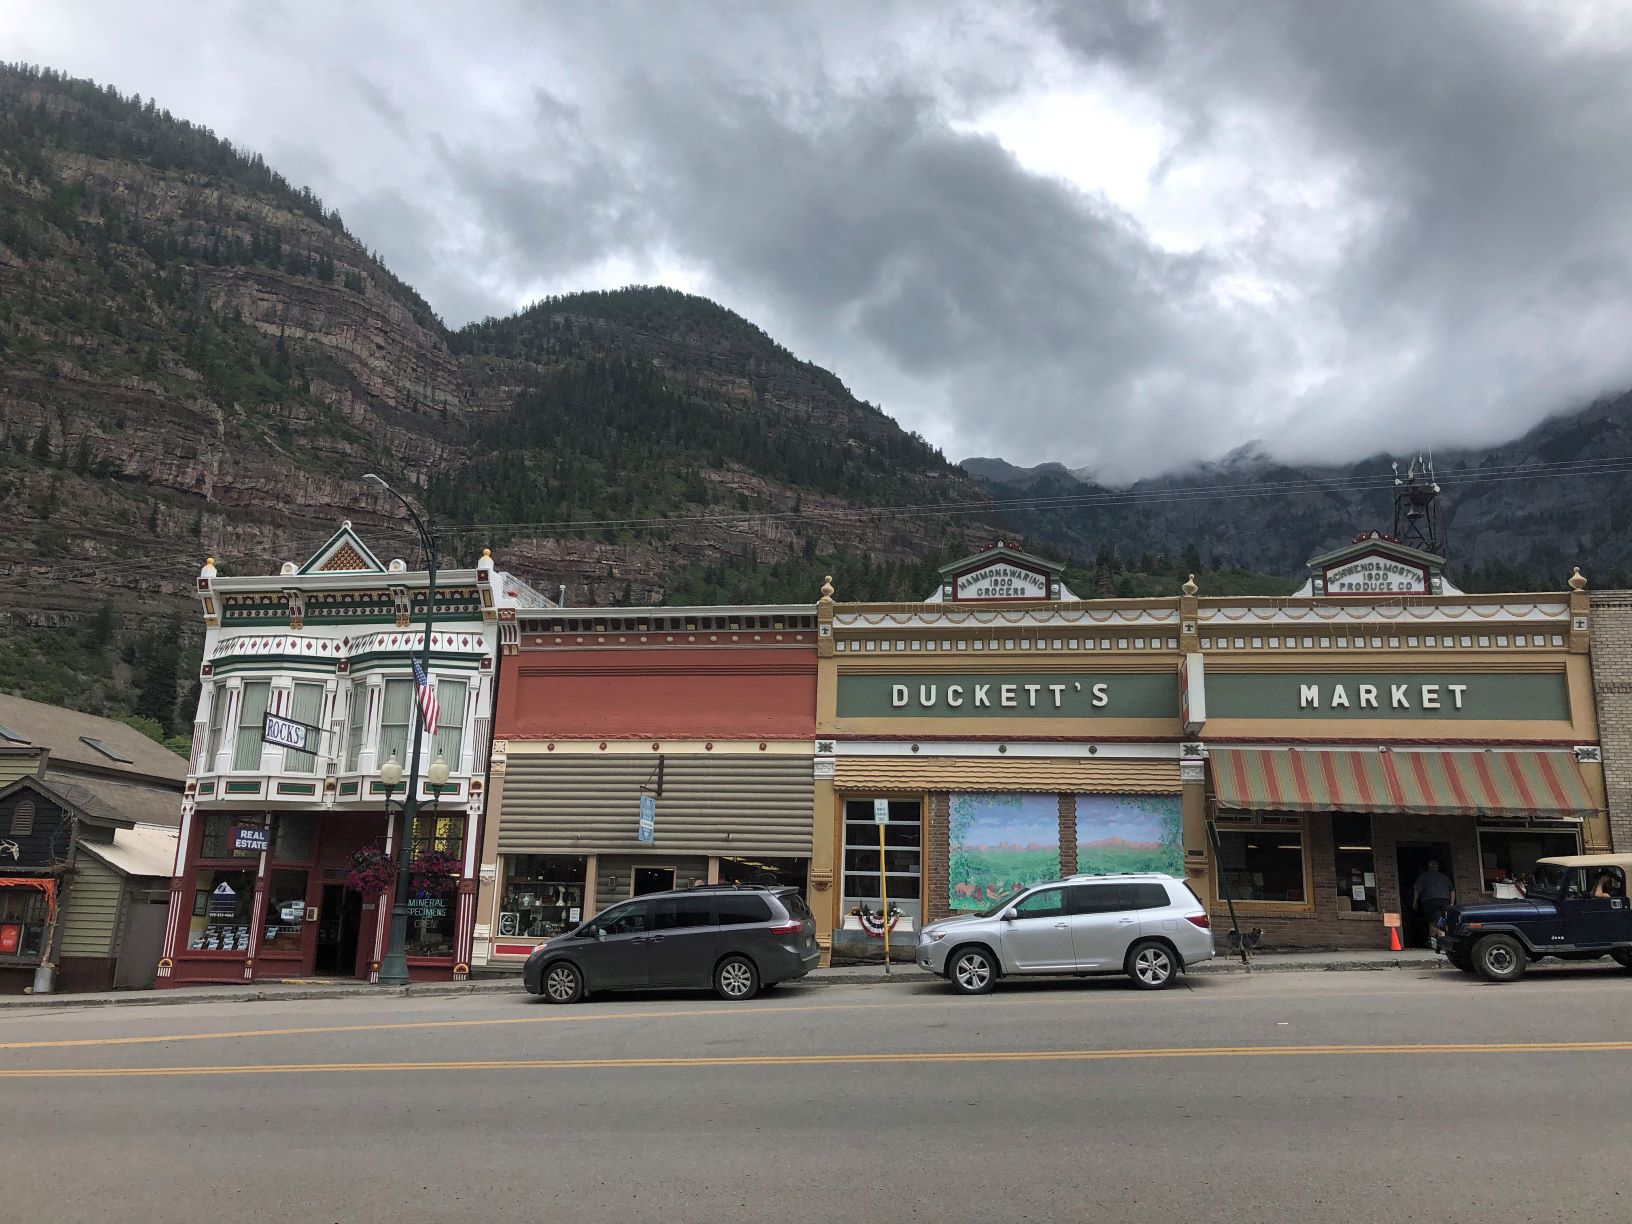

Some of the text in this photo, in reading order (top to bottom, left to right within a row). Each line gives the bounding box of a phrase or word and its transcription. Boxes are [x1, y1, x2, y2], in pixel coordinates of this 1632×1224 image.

[1363, 572, 1389, 582] 1900
[989, 578, 1013, 588] 1900
[1340, 581, 1413, 592] PRODUCE CO
[976, 587, 1026, 597] GROCERS
[892, 681, 1108, 708] DUCKETT'S
[1300, 684, 1467, 709] MARKET
[267, 718, 301, 744] ROCKS
[240, 829, 265, 840] REAL
[235, 838, 268, 850] ESTATE
[407, 898, 446, 908] MINERAL
[406, 907, 447, 917] SPECIMENS
